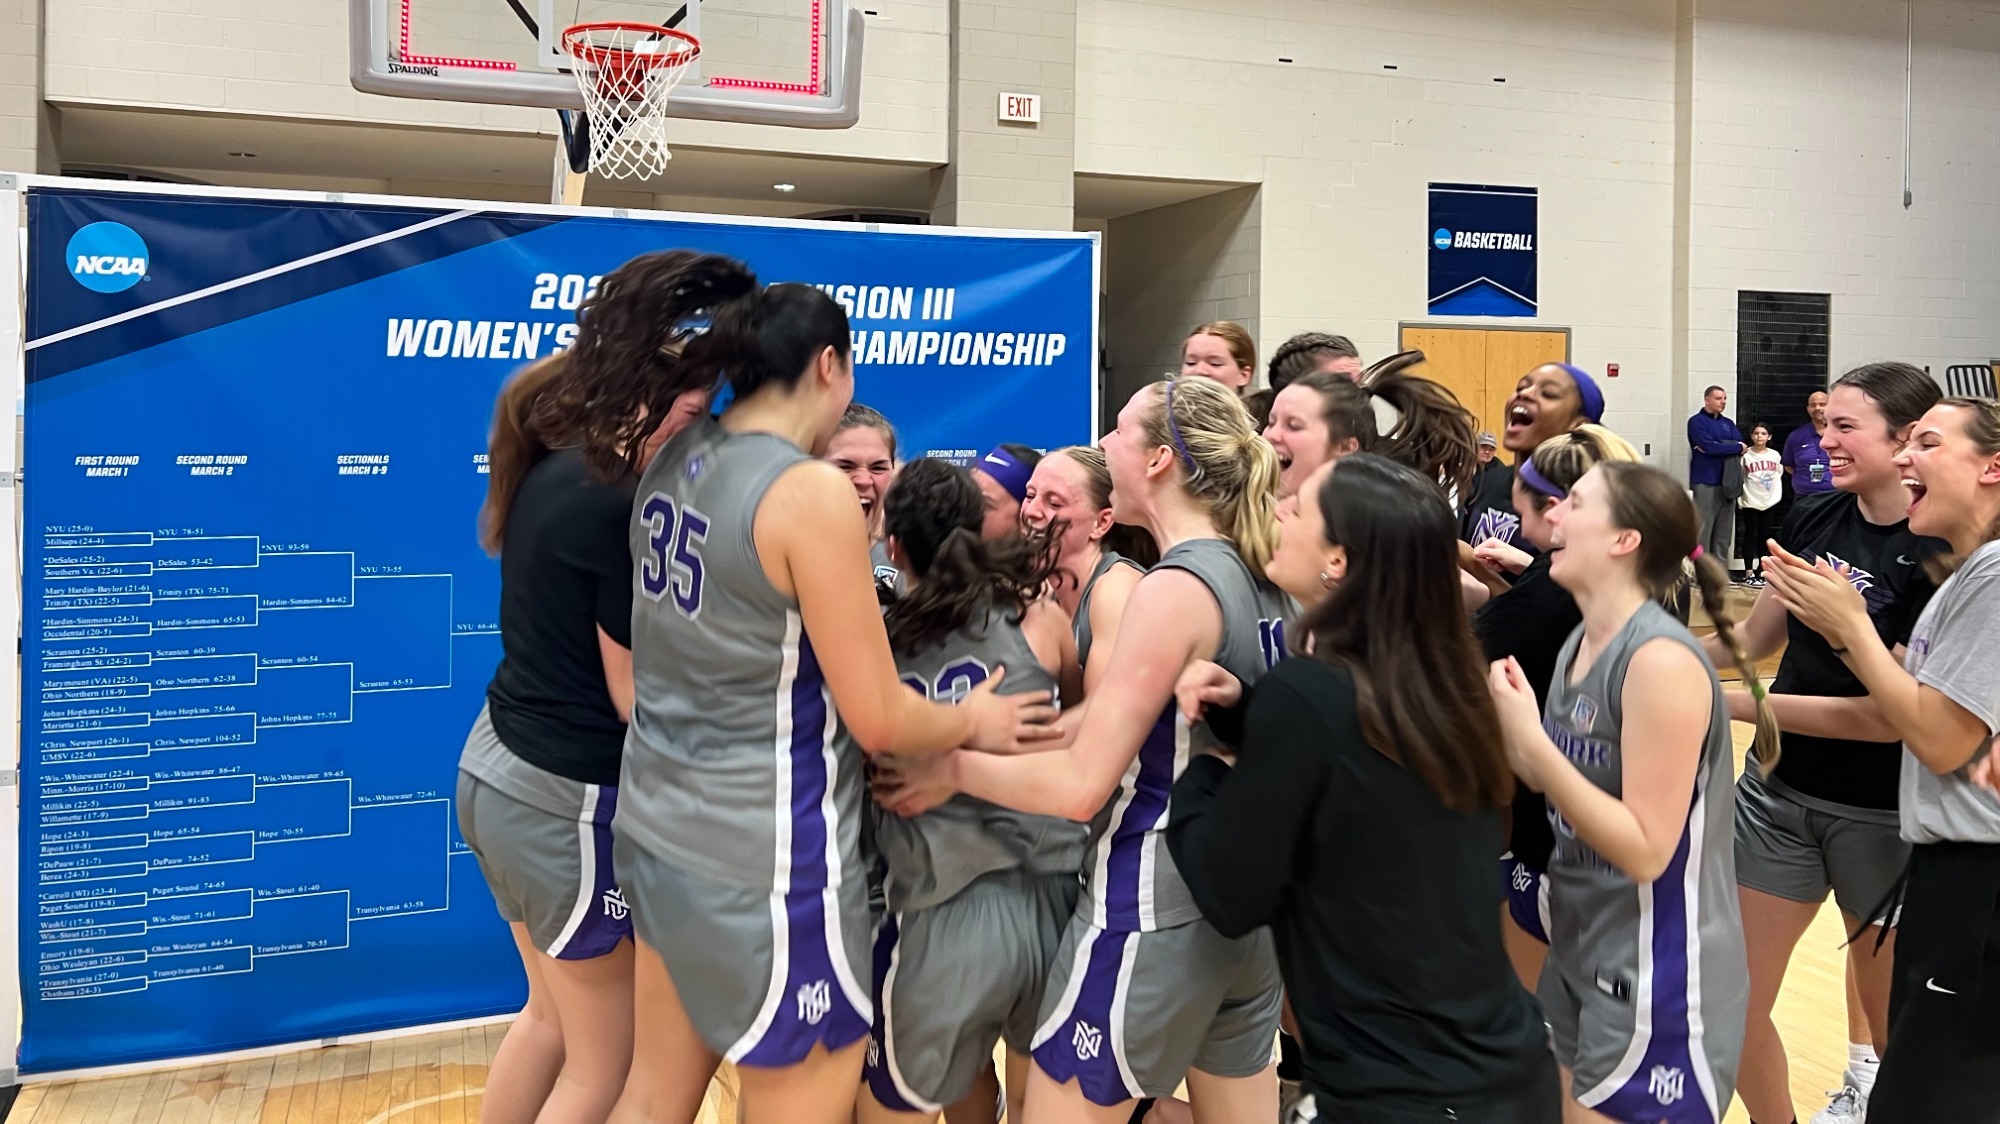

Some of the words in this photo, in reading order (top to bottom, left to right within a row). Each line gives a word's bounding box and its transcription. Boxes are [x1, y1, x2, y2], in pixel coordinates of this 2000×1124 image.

[388, 63, 440, 77] SPALDING
[1008, 96, 1033, 118] EXIT
[1454, 231, 1533, 251] BASKETBALL
[74, 255, 146, 276] NCAA
[922, 288, 955, 320] III
[387, 318, 580, 360] WOMEN'S
[850, 330, 1066, 366] HAMPIONSHIP
[75, 456, 104, 466] FIRST
[105, 456, 139, 465] ROUND
[176, 456, 213, 464] SECOND
[215, 456, 247, 464] ROUND
[337, 455, 389, 464] SECTIONALS
[86, 468, 120, 476] MARCH
[123, 468, 128, 476] 1
[191, 467, 224, 475] MARCH
[226, 467, 233, 475] 2
[339, 466, 370, 475] MARCH
[372, 466, 387, 474] 8-9
[640, 490, 710, 621] 35
[45, 599, 71, 607] Trinity
[73, 598, 92, 606] (TX)
[44, 660, 92, 669] Framingham
[44, 679, 89, 687] Marymount
[113, 676, 138, 684] (22-5)
[156, 678, 174, 686] Ohio
[64, 690, 99, 698] Northern
[179, 707, 209, 715] Hopkins
[261, 715, 281, 723] Johns
[283, 714, 312, 722] Hopkins
[70, 739, 102, 748] Newport
[179, 737, 210, 745] Newport
[42, 753, 69, 761] UMSV
[71, 751, 96, 759] (22-6)
[96, 783, 125, 792] (17-10)
[42, 802, 72, 811] Millikin
[74, 801, 99, 809] (22-5)
[154, 799, 183, 807] Millikin
[42, 814, 82, 823] Willamette
[84, 812, 108, 820] (17-9)
[41, 833, 62, 841] Hope
[64, 830, 89, 838] (24-3)
[154, 829, 173, 837] Hope
[259, 830, 278, 838] Hope
[41, 845, 64, 854] Ripon
[153, 858, 182, 866] DePauw
[64, 871, 89, 879] (24-3)
[72, 890, 90, 898] (WI)
[92, 888, 116, 896] (23-4)
[153, 886, 174, 896] Puget
[176, 884, 199, 892] Sound
[41, 904, 62, 914] Puget
[65, 902, 88, 910] Sound
[356, 904, 400, 914] Transylvania
[173, 942, 207, 951] Wesleyan
[257, 944, 302, 953] Transylvania
[41, 951, 67, 960] Emory
[62, 959, 97, 969] Wesleyan
[153, 967, 200, 977] Transylvania
